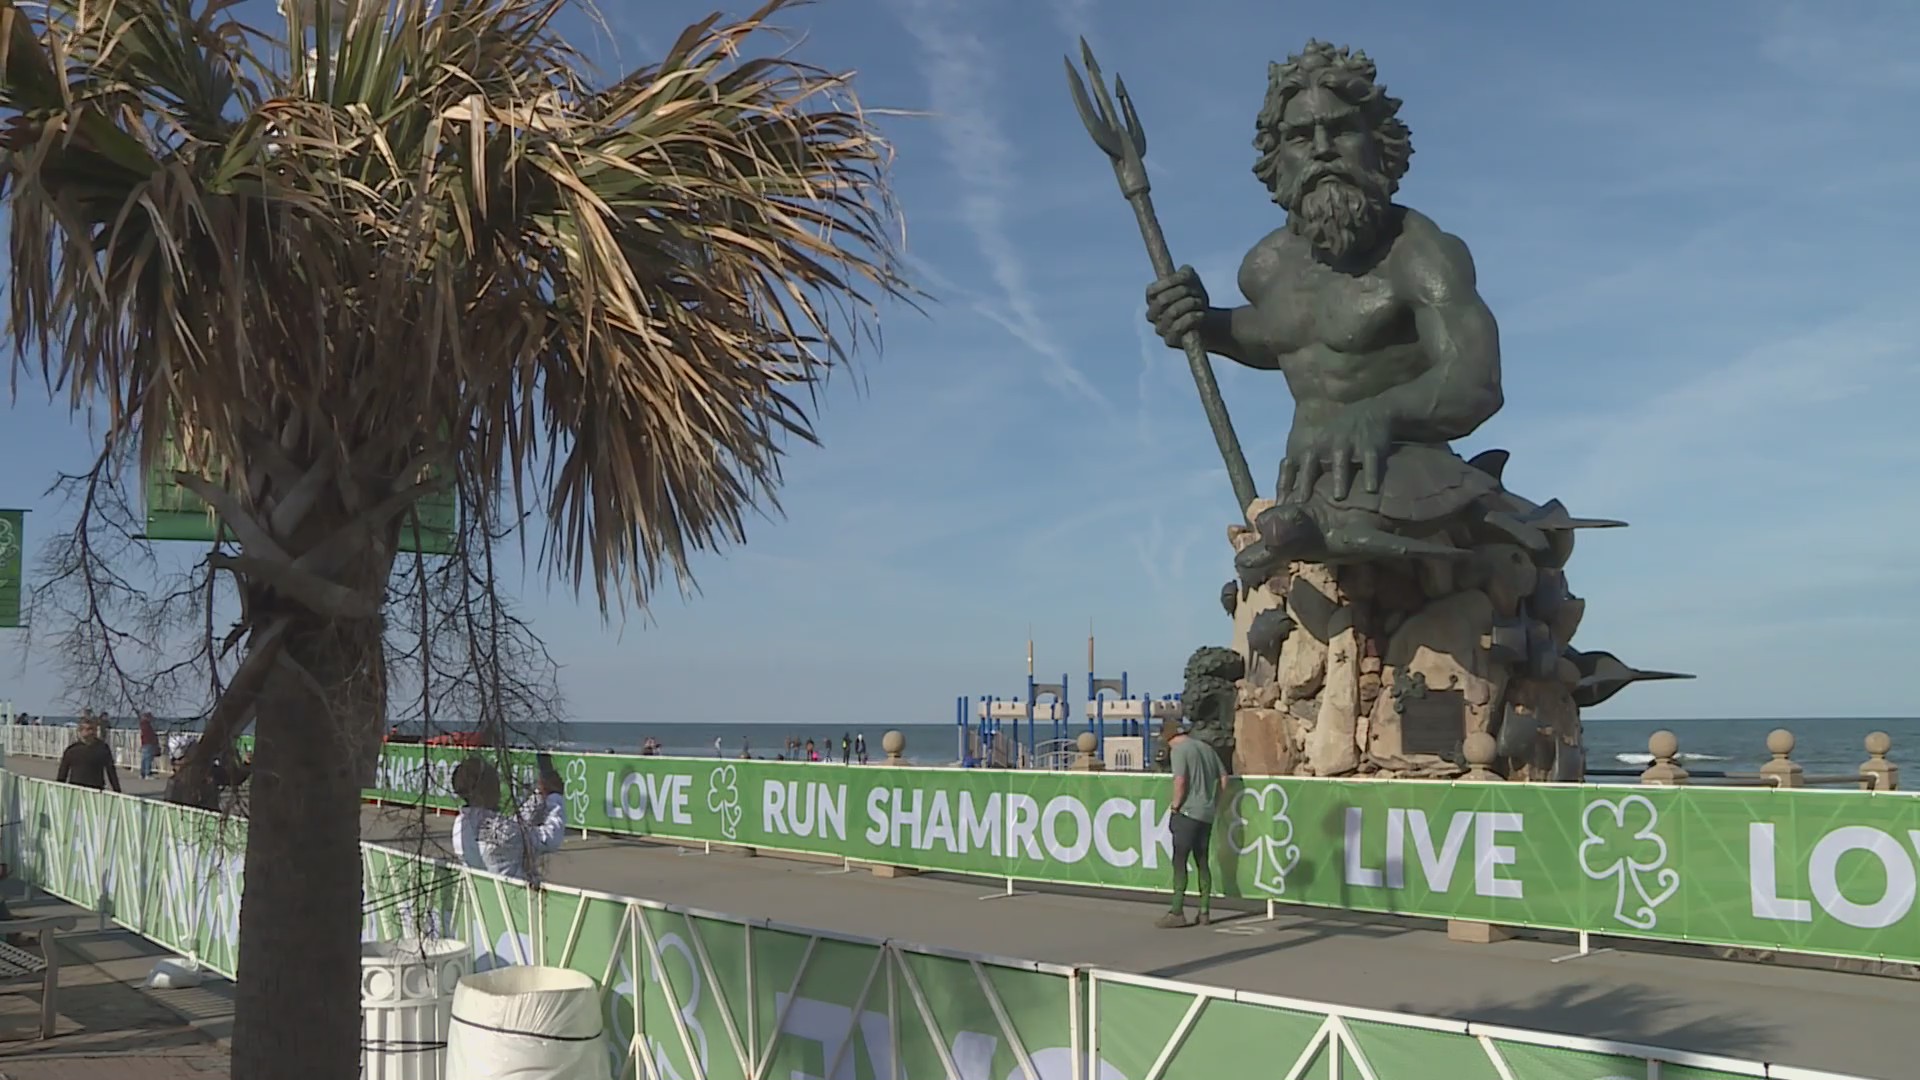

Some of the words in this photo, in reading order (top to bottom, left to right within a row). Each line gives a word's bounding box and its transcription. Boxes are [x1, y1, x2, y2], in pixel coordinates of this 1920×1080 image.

[606, 771, 692, 825] LOVE
[763, 780, 847, 841] RUN
[866, 787, 1193, 872] SHAMROCK
[1344, 807, 1524, 898] LIVE
